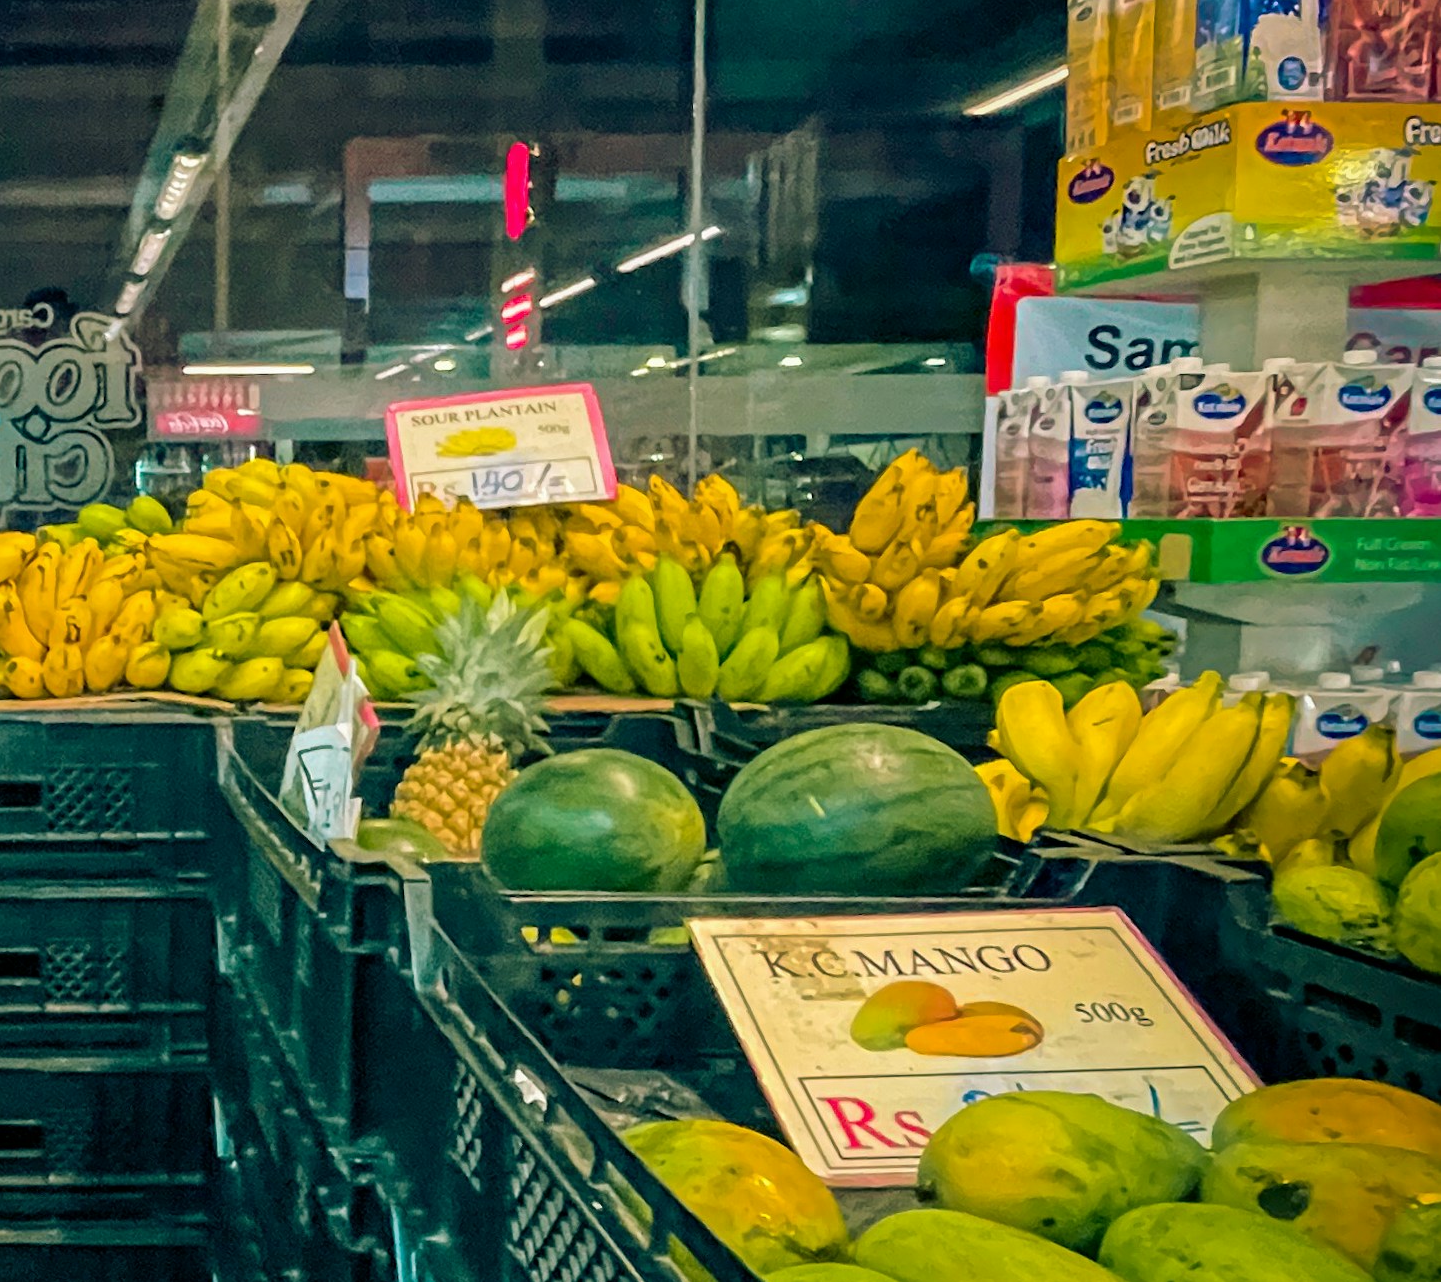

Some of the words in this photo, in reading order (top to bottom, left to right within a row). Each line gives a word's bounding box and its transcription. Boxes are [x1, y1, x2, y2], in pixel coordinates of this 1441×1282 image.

[411, 412, 462, 427] SOUR
[465, 401, 558, 423] PLANTAIN
[1074, 1001, 1155, 1027] 500g
